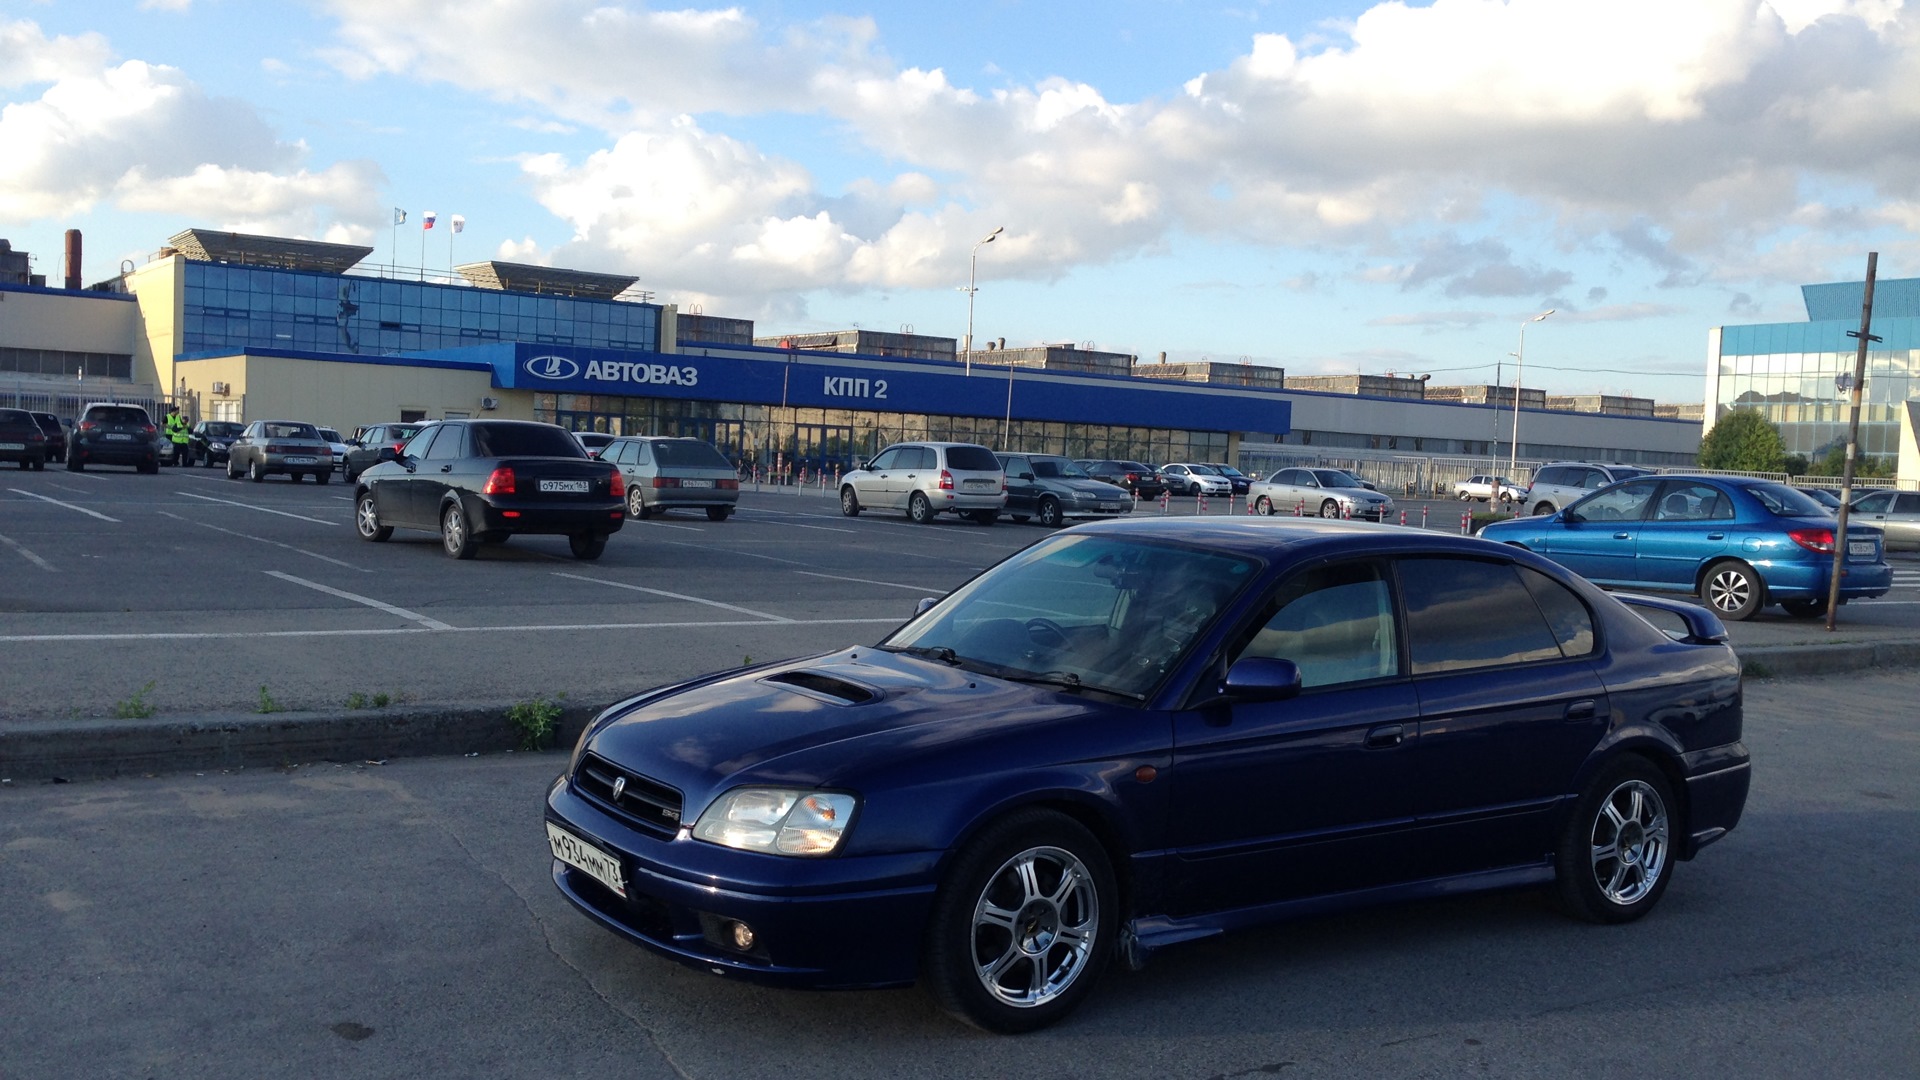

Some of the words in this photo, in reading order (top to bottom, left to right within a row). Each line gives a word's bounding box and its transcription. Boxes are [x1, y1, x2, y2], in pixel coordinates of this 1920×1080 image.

[584, 360, 698, 387] АВТОВАЗ
[823, 376, 869, 398] КПП
[874, 380, 887, 399] 2
